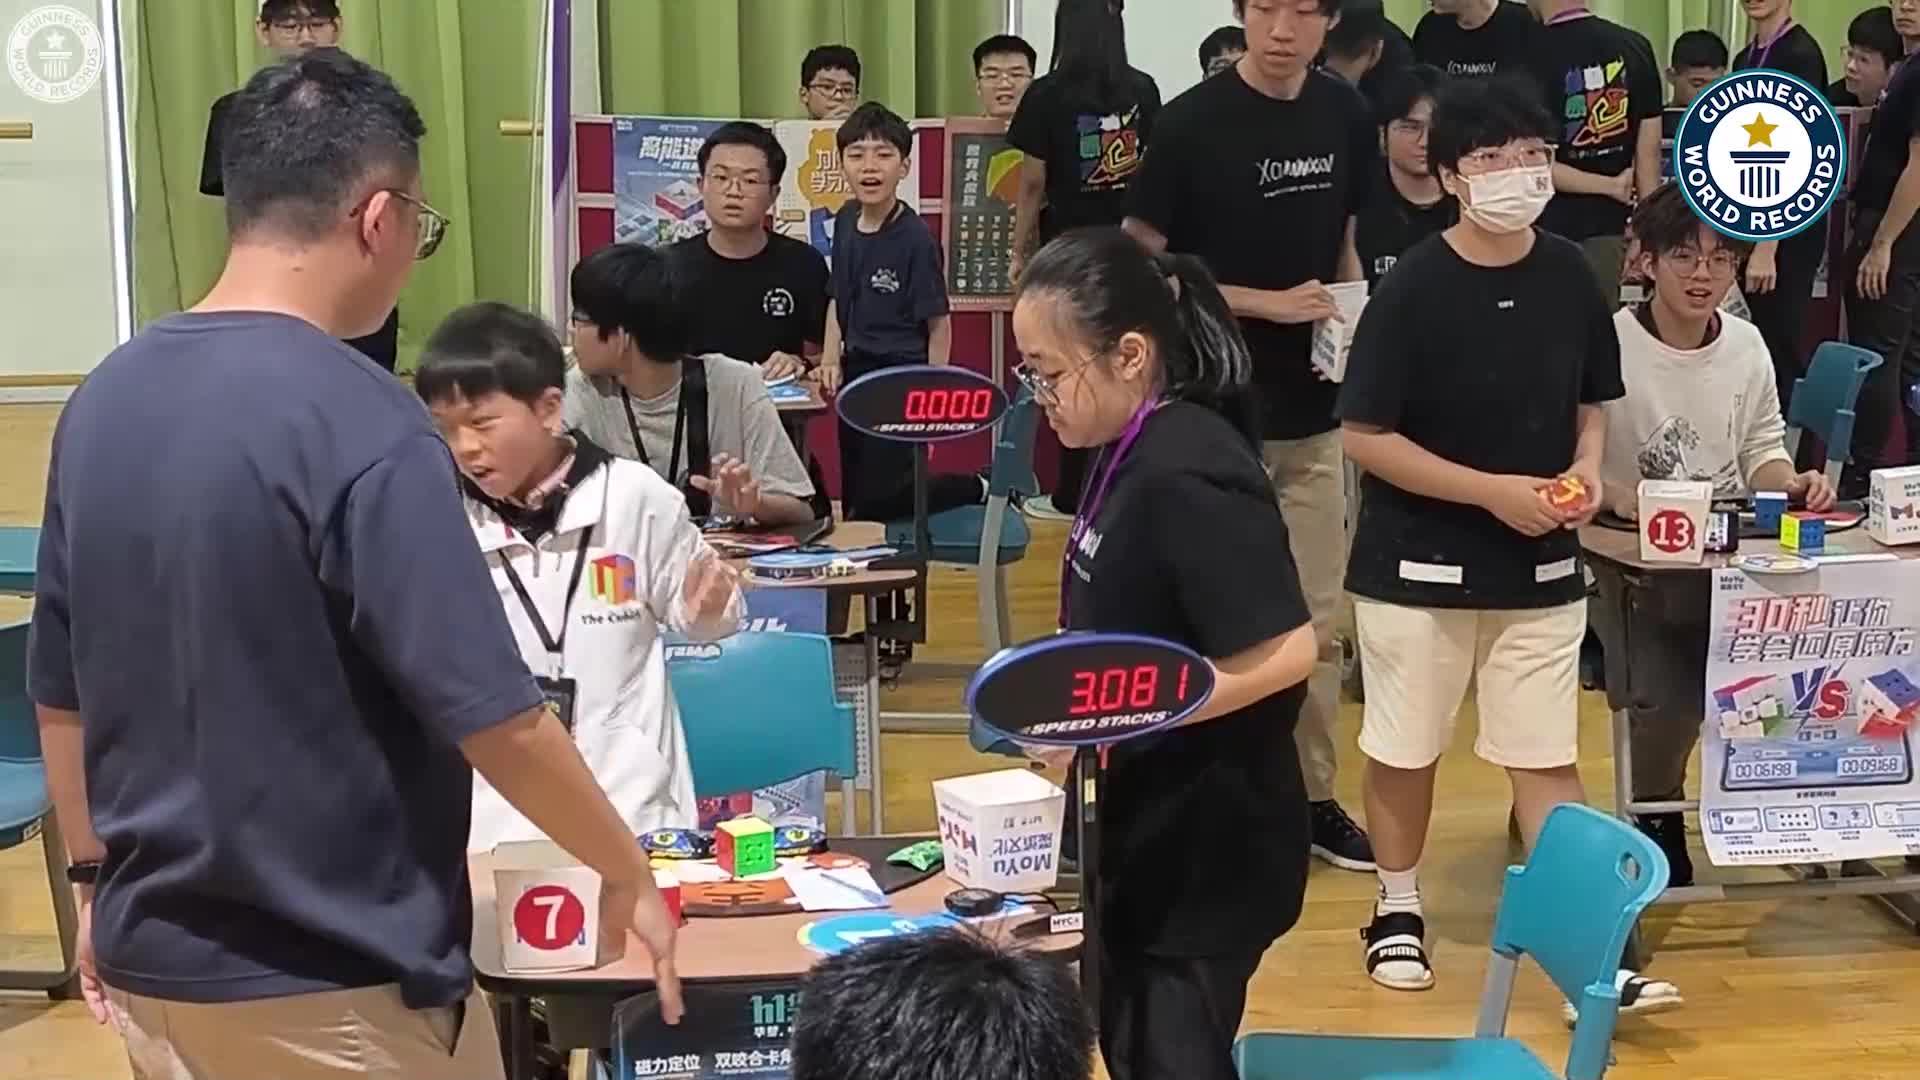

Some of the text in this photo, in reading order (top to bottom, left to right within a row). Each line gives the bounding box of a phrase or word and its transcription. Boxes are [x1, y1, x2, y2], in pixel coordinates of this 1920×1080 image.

[904, 389, 993, 420] 0.000
[879, 422, 976, 432] SPEED STACKS
[1653, 515, 1691, 547] 13
[1736, 594, 1892, 634] 30秒让你
[1730, 627, 1917, 663] 学会还原魔方
[1069, 663, 1190, 715] 3.081
[1791, 665, 1850, 720] VS
[1031, 710, 1169, 736] SPEED STACKS
[993, 852, 1053, 877] MoYu
[532, 894, 566, 941] 7
[1378, 945, 1420, 958] PUMA
[635, 1054, 701, 1076] 磁力定位
